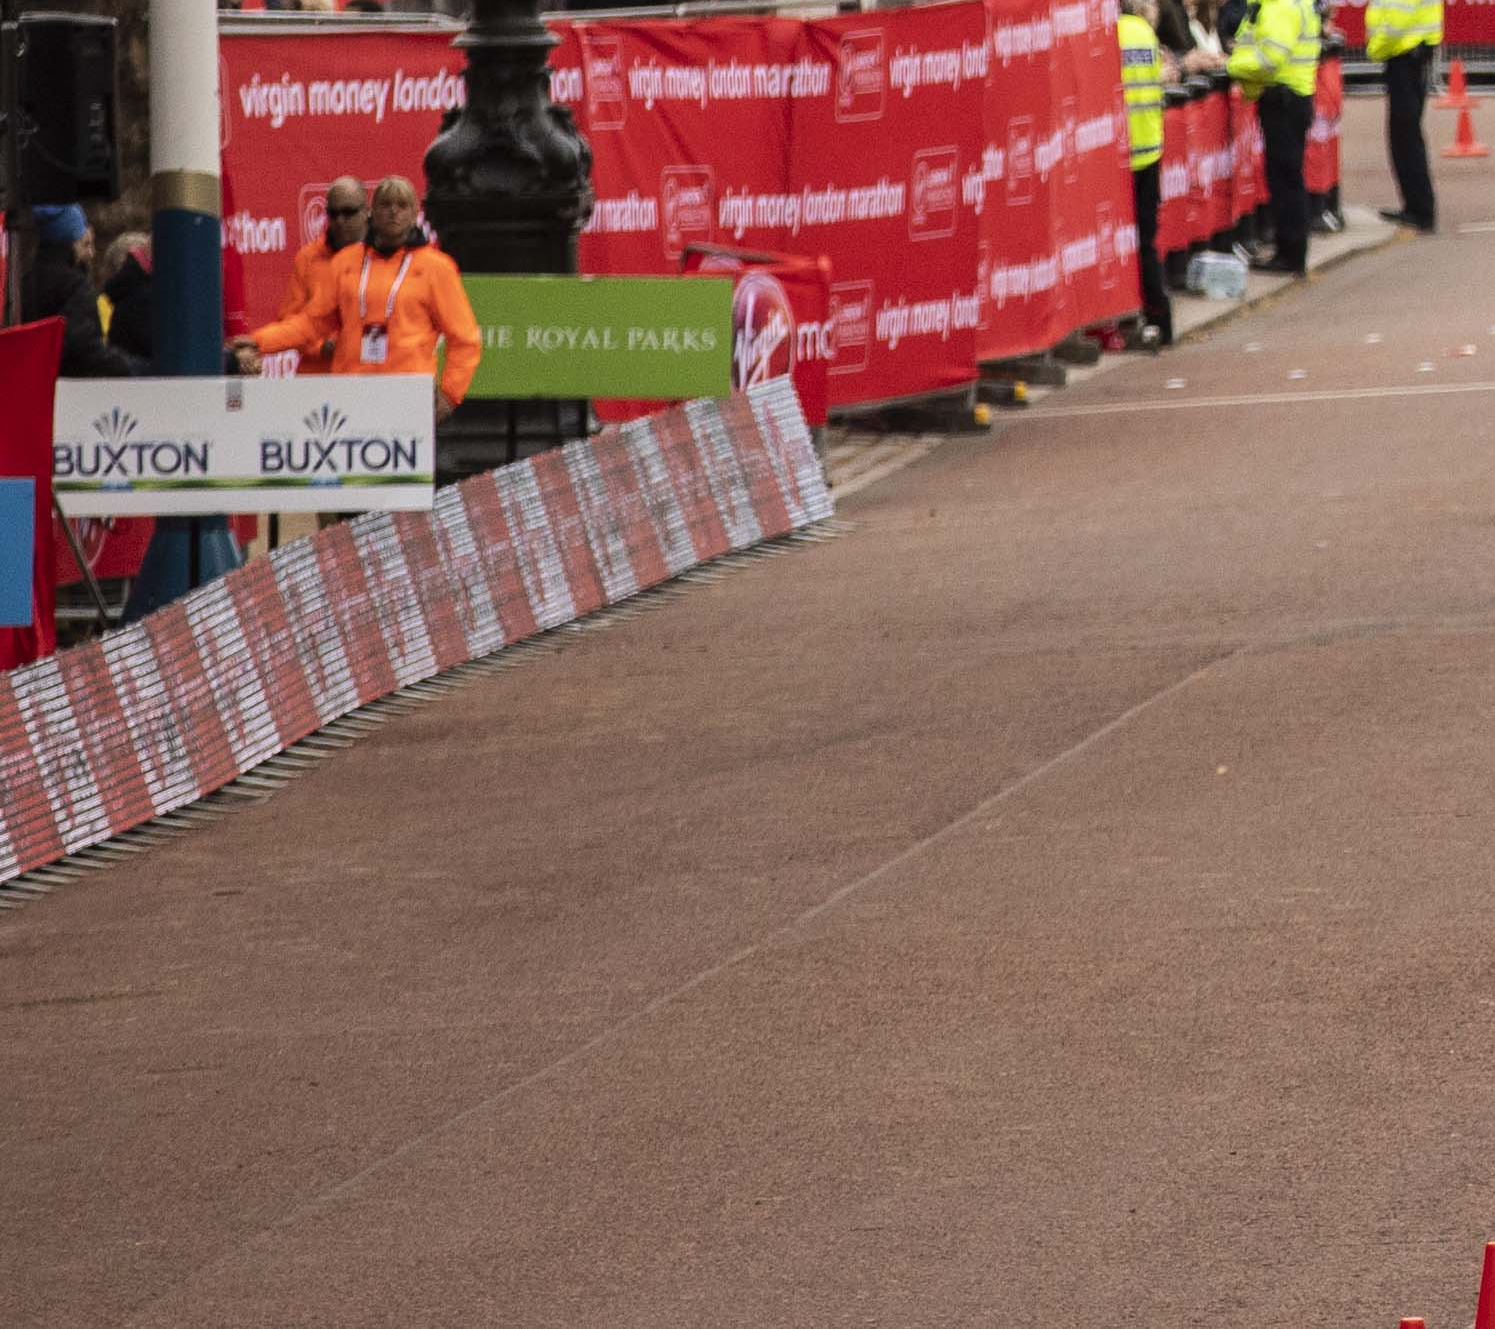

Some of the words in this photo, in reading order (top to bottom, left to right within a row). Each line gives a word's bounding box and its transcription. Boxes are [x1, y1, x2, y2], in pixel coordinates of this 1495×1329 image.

[238, 72, 305, 128] virgin
[308, 77, 391, 123] money
[628, 54, 662, 110] virgin
[708, 56, 752, 100] london
[718, 184, 754, 240] virgin
[802, 182, 846, 225] london
[479, 325, 513, 350] HE
[525, 324, 616, 353] ROYAL
[627, 326, 719, 353] PARKS
[52, 442, 209, 478] BUXTON
[259, 438, 418, 475] BUXTON
